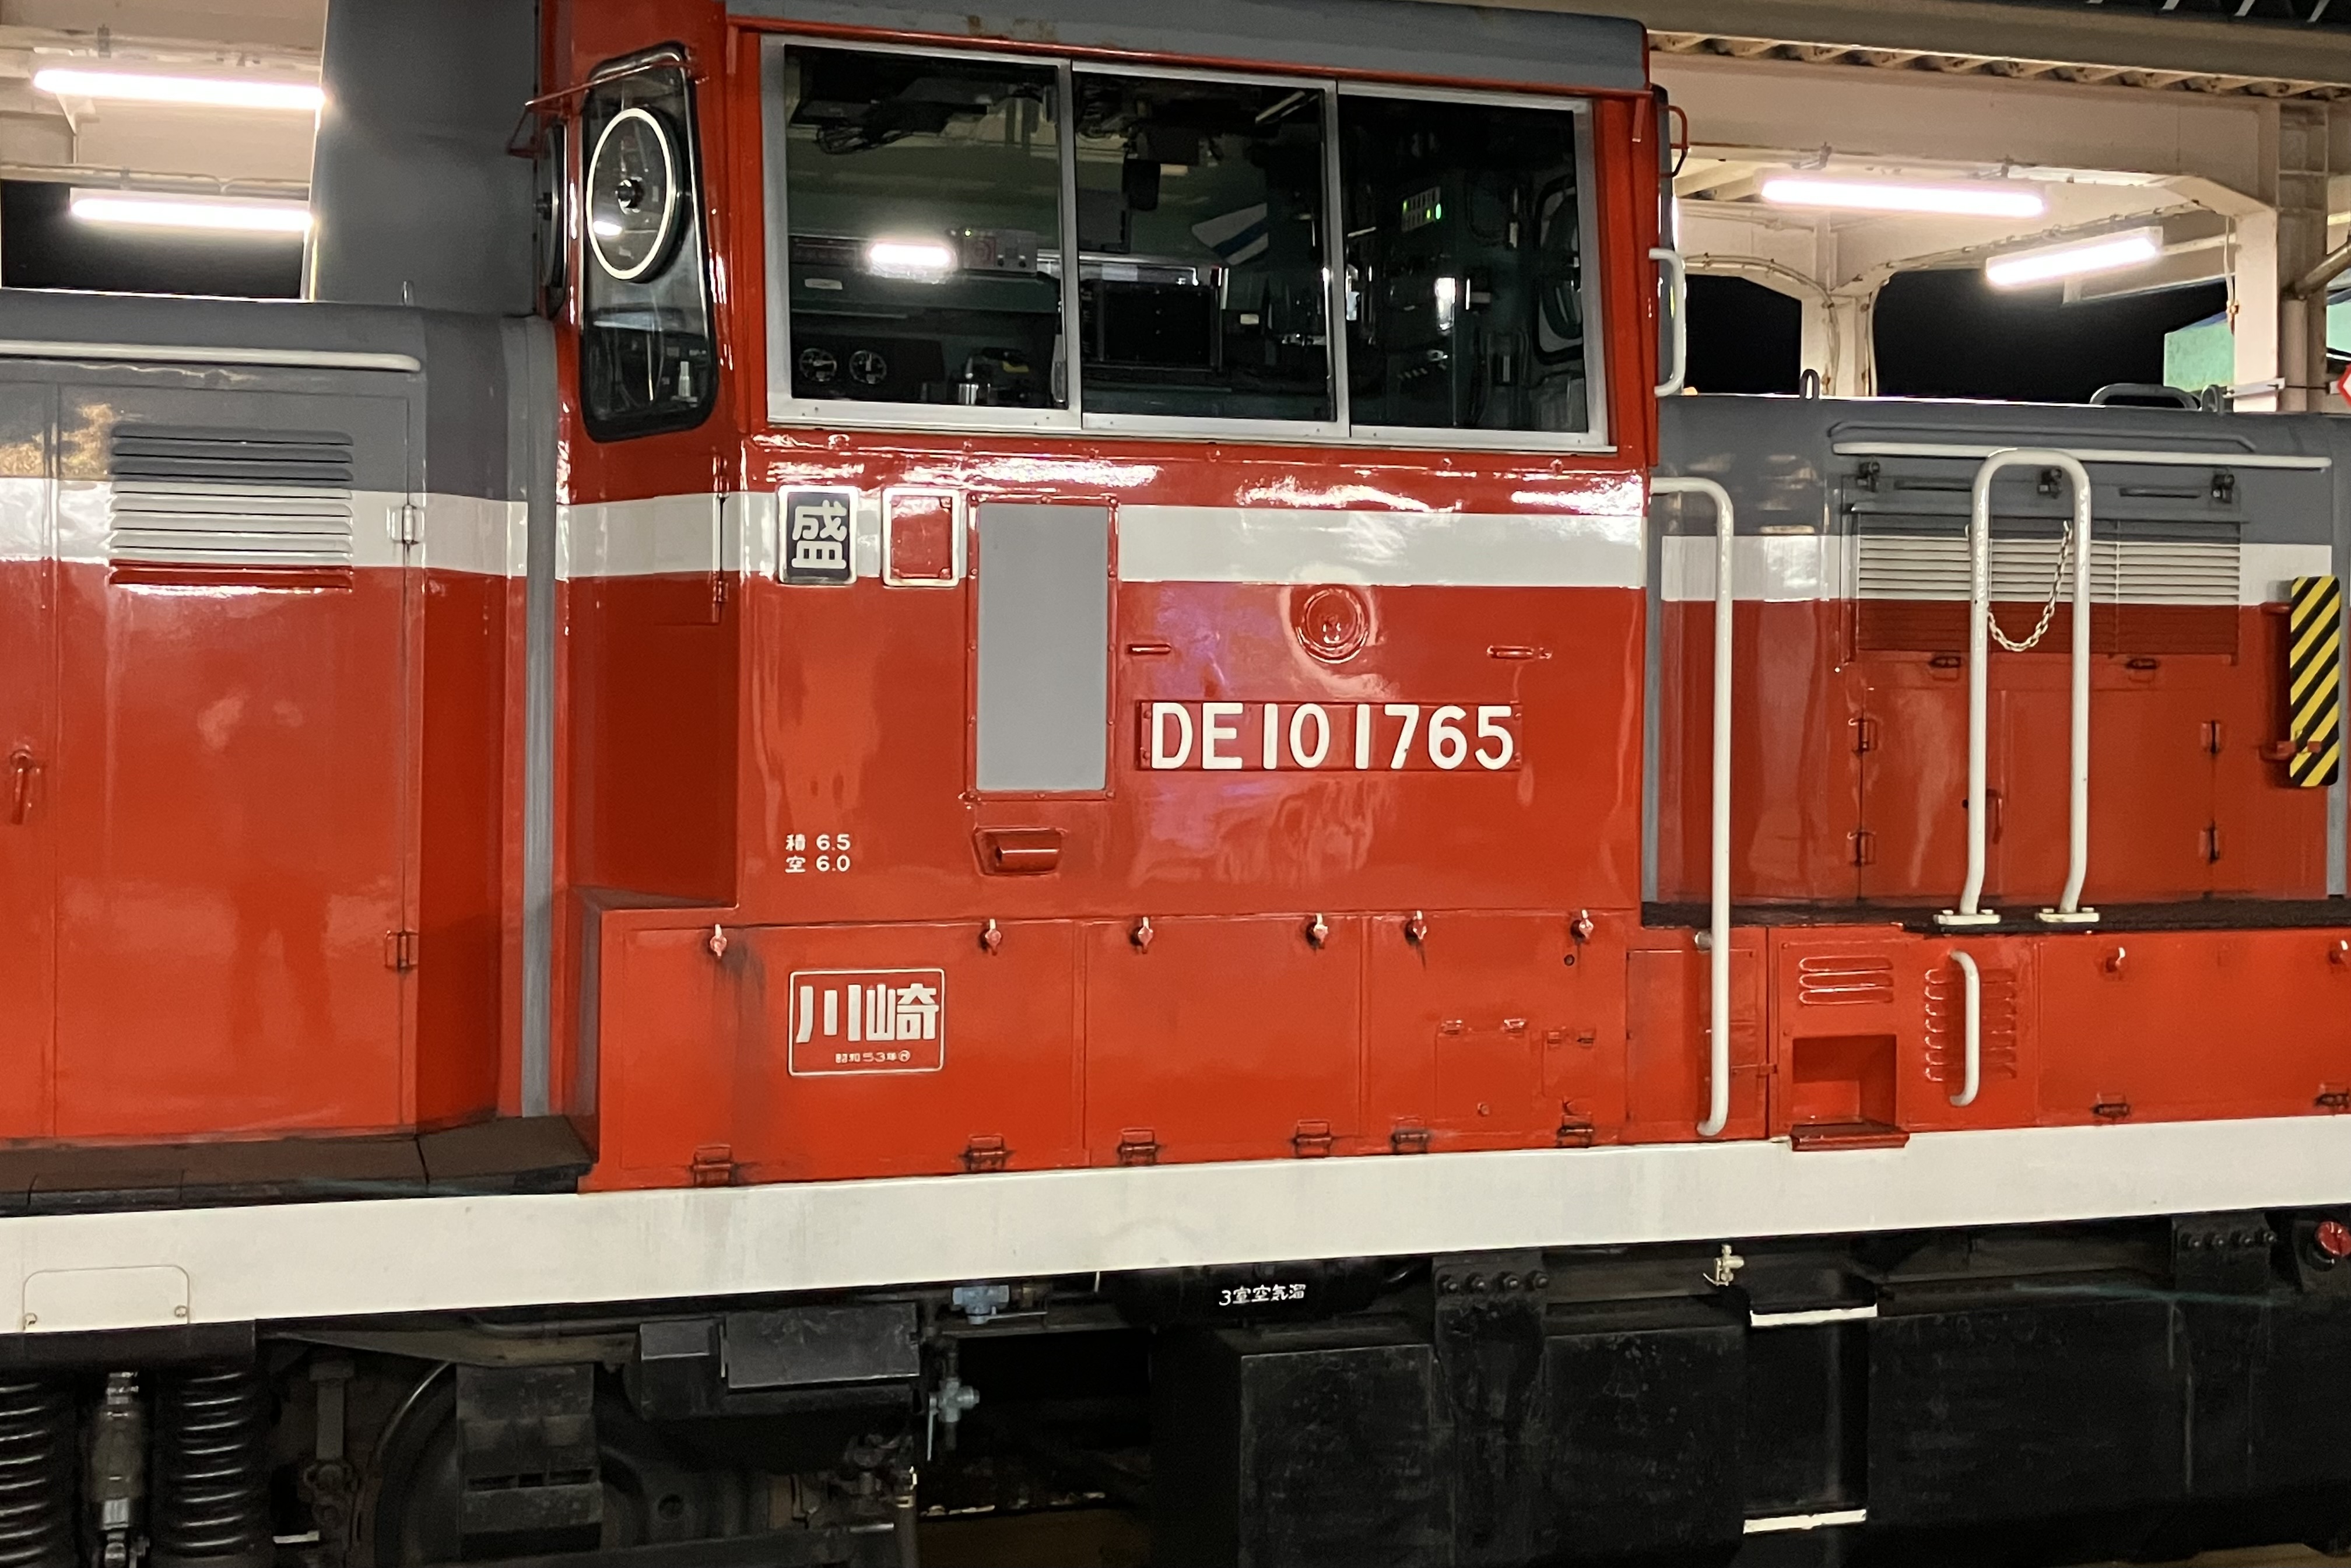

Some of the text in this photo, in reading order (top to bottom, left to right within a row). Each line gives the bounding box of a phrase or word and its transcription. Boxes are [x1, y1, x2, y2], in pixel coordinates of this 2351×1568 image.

[791, 499, 848, 569] 盛
[1355, 703, 1514, 770] 1765
[785, 855, 851, 873] 空 6.0
[816, 834, 851, 851] 6.5
[796, 983, 939, 1043] 川崎
